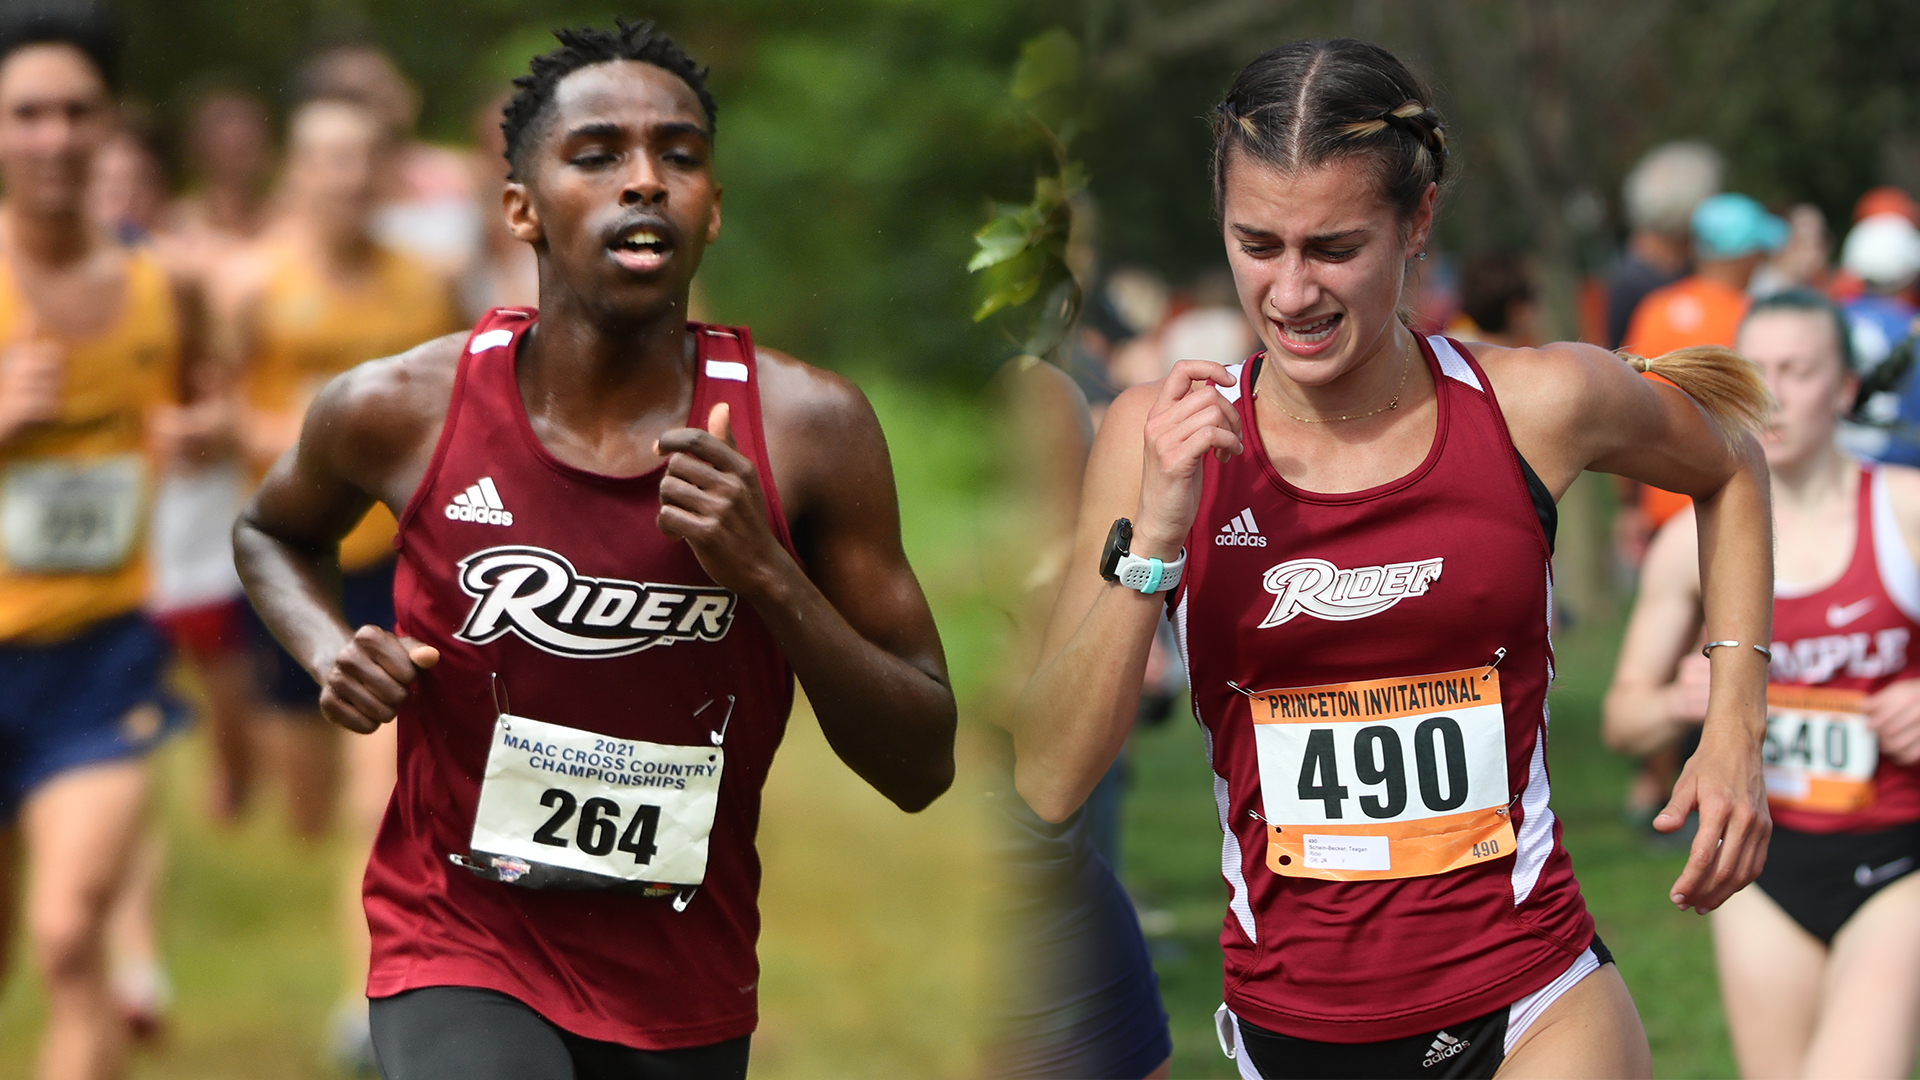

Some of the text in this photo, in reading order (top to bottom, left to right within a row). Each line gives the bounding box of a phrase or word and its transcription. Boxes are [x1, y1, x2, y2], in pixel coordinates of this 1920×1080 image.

[445, 503, 513, 527] adidas
[1215, 532, 1267, 548] adidas
[452, 545, 738, 659] RIDER
[1768, 627, 1910, 684] MPLE
[1268, 676, 1481, 719] PRINCETON INVITATIONAL
[503, 734, 717, 778] MAAC CROSS COUNTRY
[594, 739, 635, 757] 2021
[529, 757, 686, 790] CHAMPIONSHIPS
[1297, 716, 1469, 820] 490
[532, 788, 661, 865] 264
[1472, 839, 1500, 859] 490
[1422, 1038, 1470, 1068] adidas
